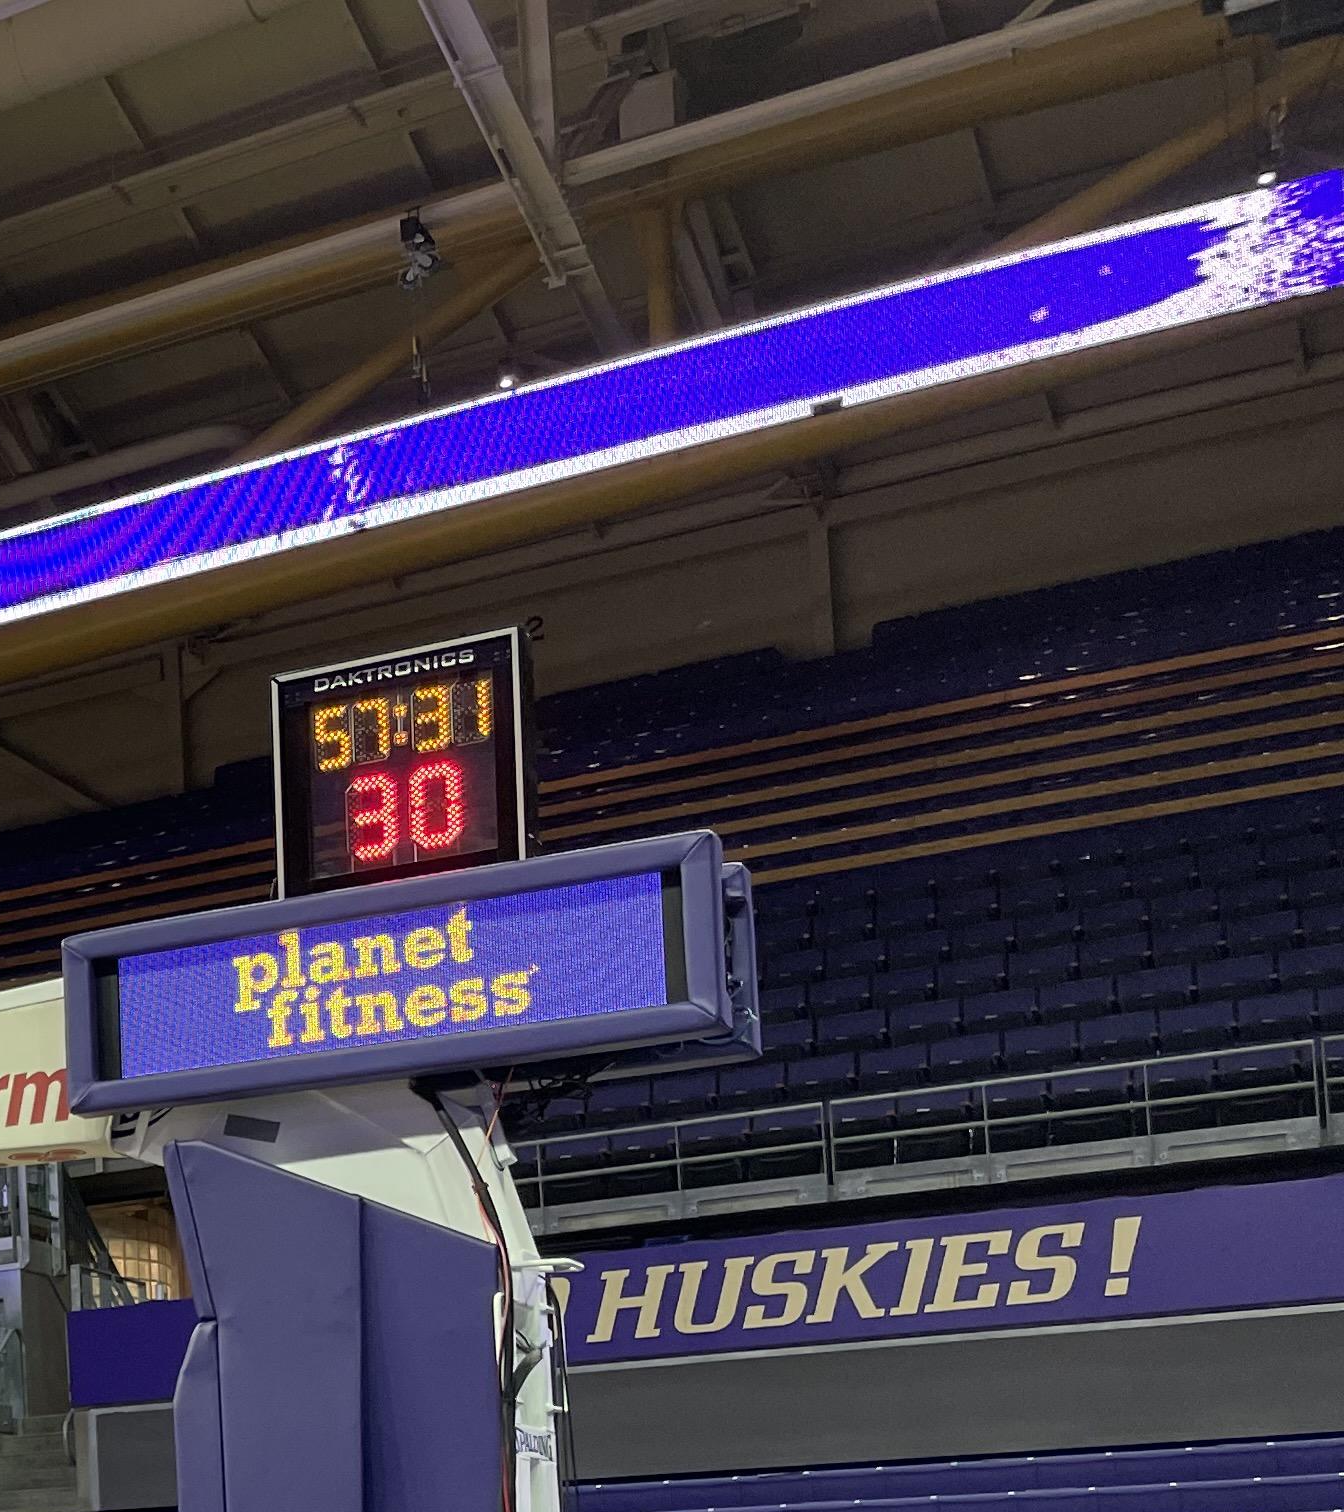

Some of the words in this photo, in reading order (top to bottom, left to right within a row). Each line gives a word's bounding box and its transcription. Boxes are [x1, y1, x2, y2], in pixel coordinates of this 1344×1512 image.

[313, 650, 474, 692] DAKTRONICS
[315, 678, 491, 772] 57:31
[347, 760, 464, 861] 30
[232, 903, 474, 1013] planet
[267, 969, 533, 1048] fitness
